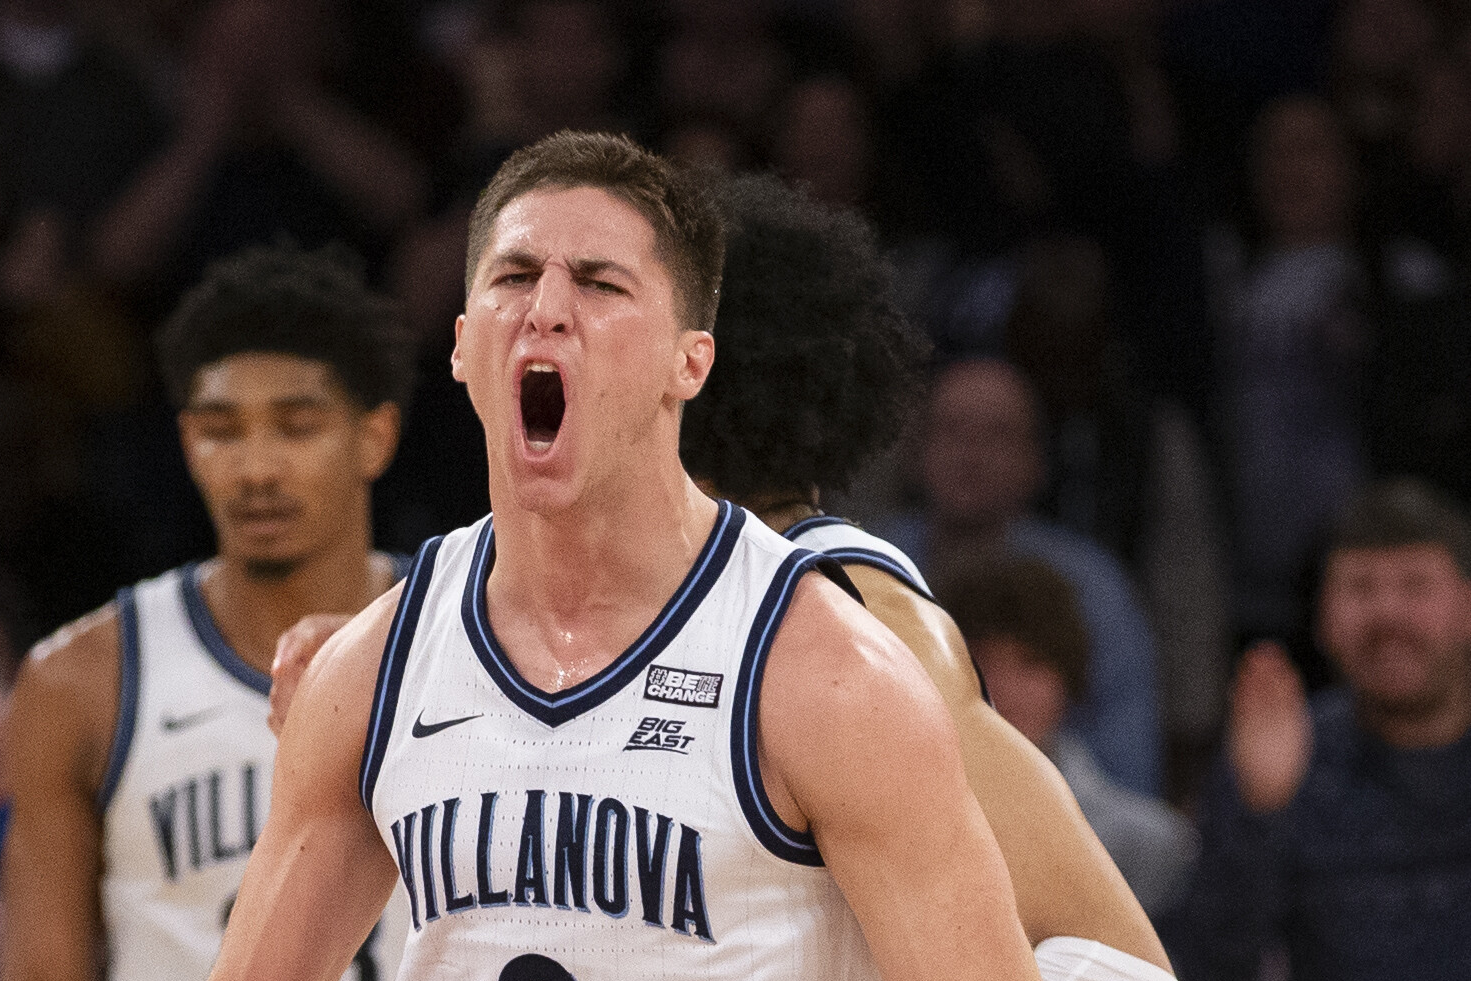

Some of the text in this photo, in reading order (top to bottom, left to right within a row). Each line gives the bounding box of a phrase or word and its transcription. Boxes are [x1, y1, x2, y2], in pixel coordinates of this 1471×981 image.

[647, 684, 717, 704] CHANGE
[637, 716, 687, 734] BIG
[627, 730, 696, 749] EAST
[390, 789, 717, 945] VILLANOVA
